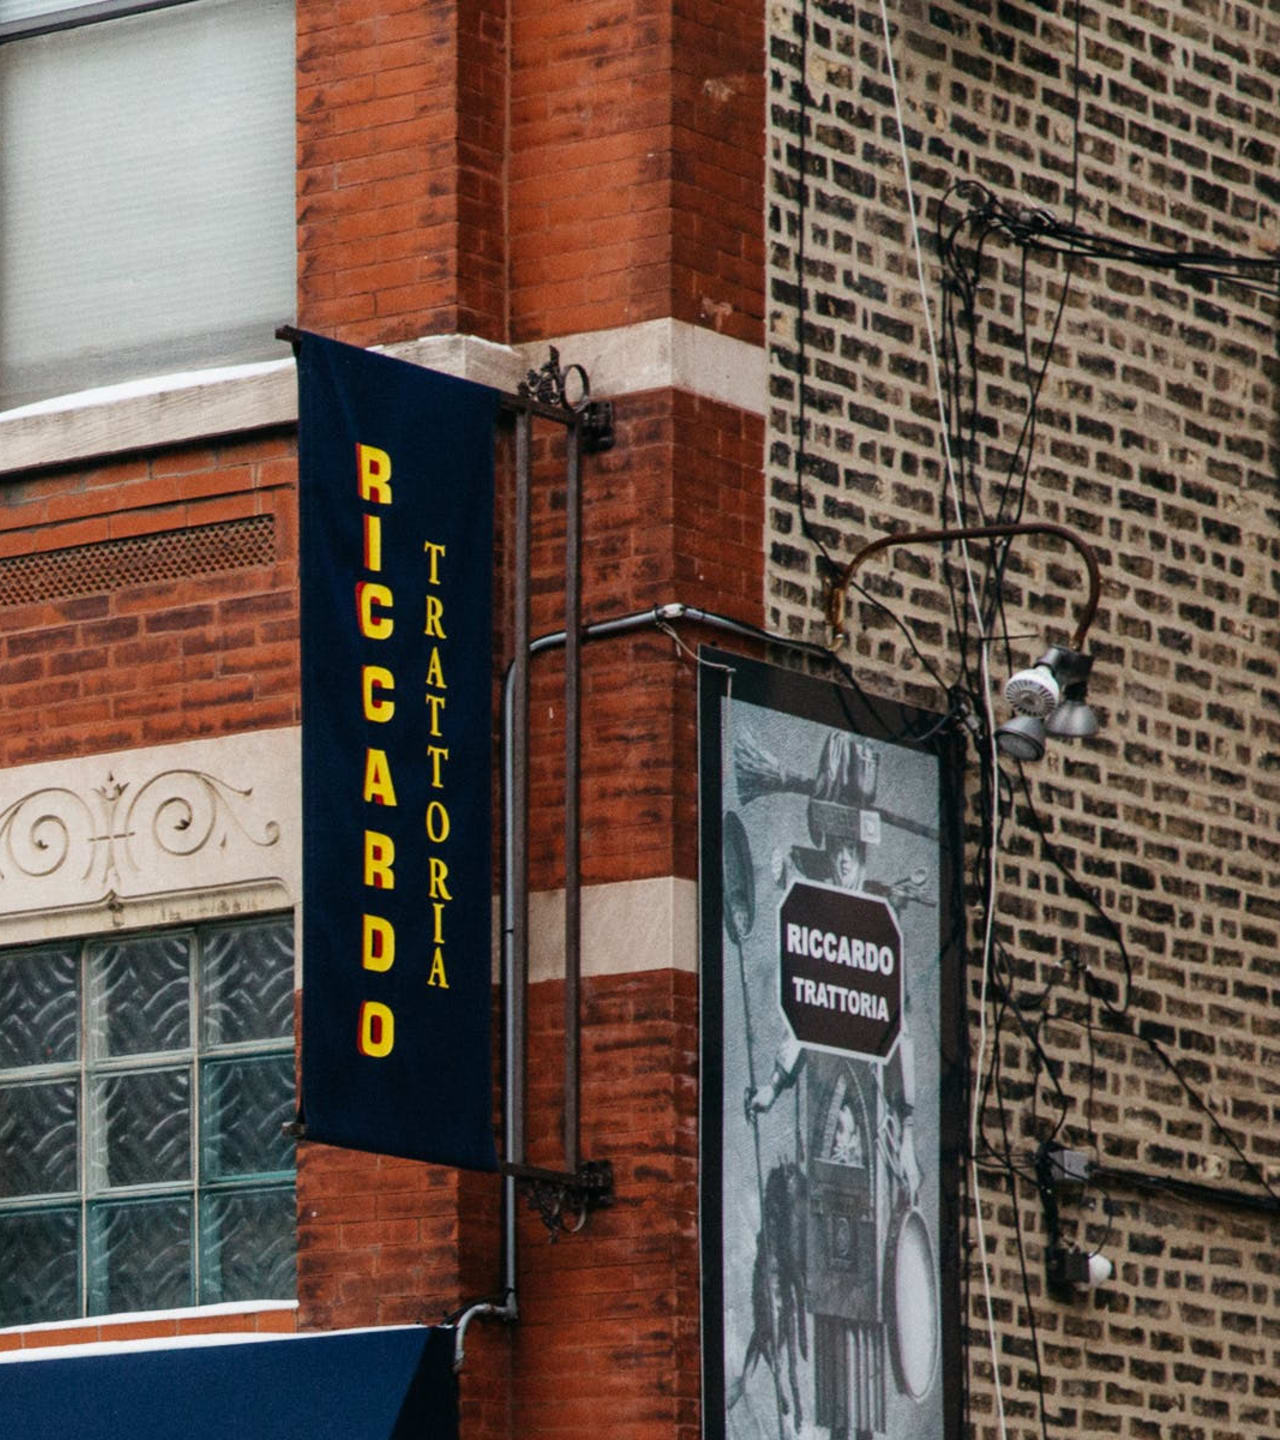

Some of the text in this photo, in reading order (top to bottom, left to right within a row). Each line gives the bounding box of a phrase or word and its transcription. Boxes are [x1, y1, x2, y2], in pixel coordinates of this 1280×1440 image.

[355, 442, 397, 1057] RICCARDO
[424, 540, 453, 990] TRATTORIA
[786, 923, 894, 976] RICCARDO
[792, 977, 890, 1023] TRATTORIA
